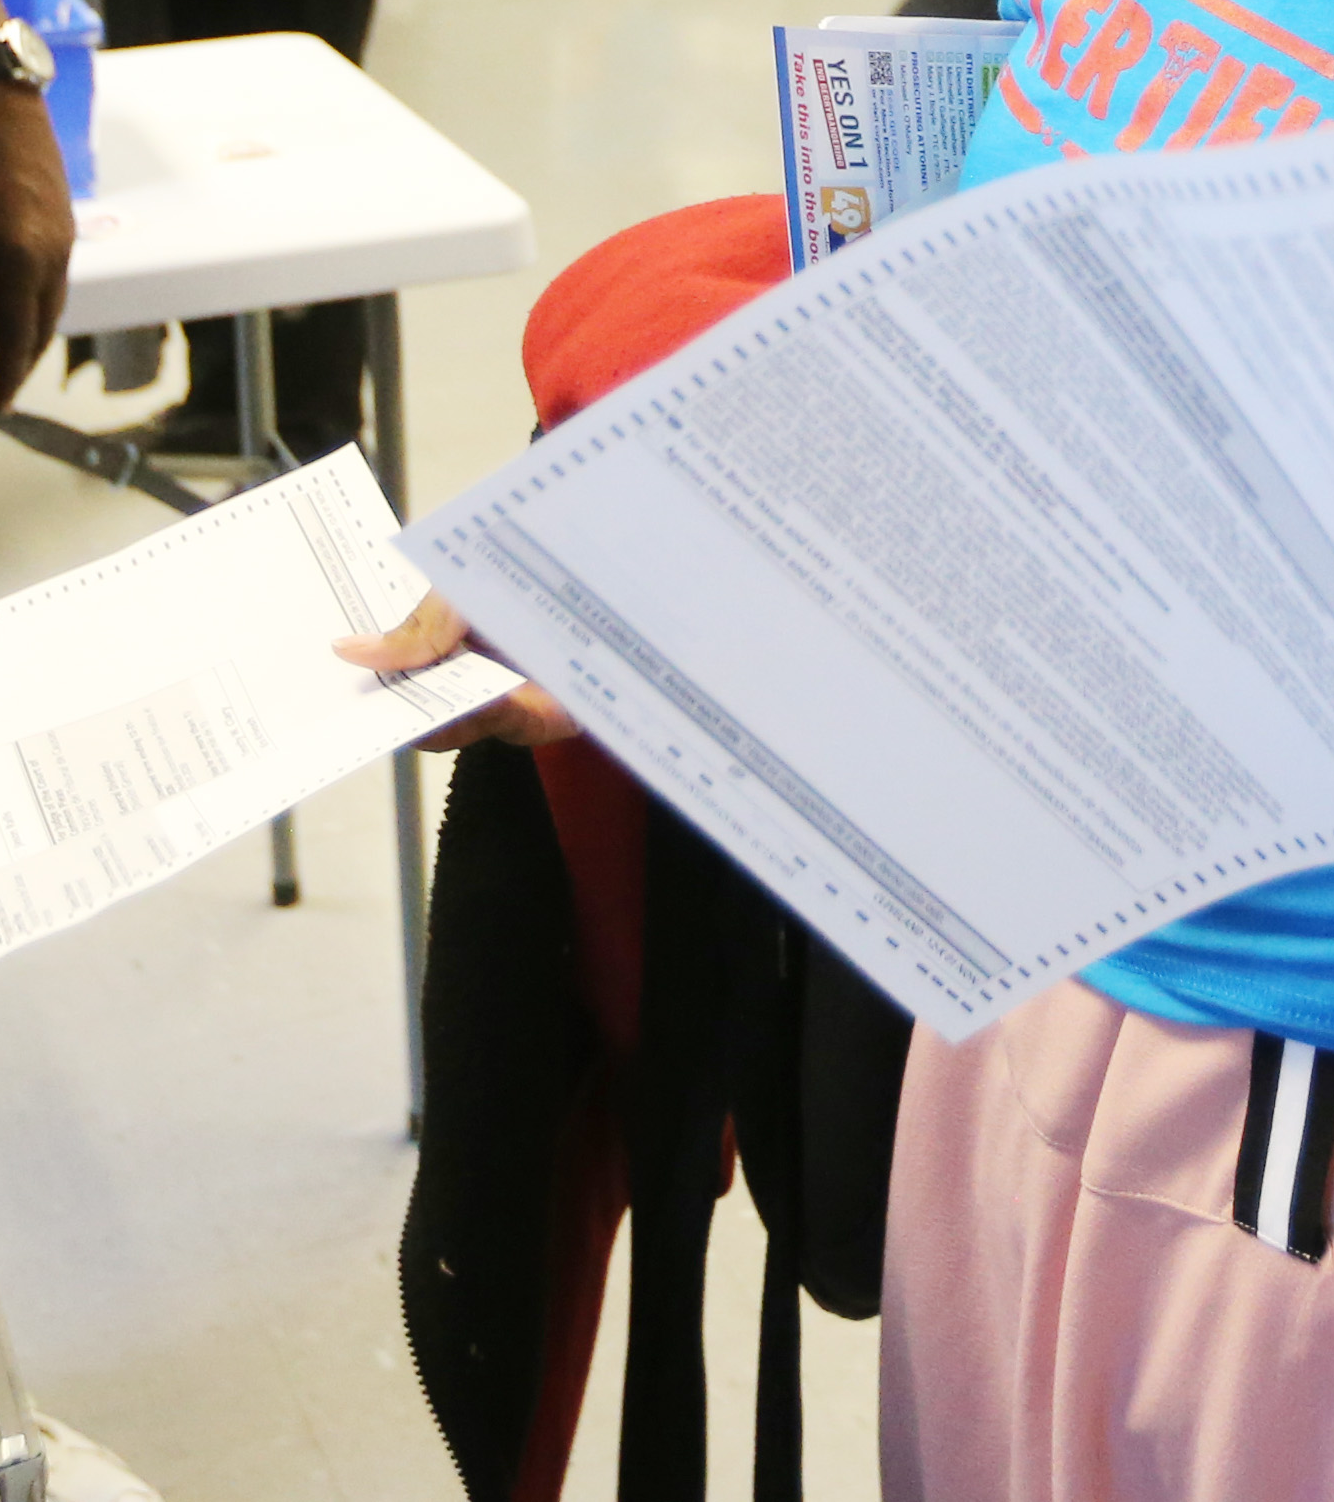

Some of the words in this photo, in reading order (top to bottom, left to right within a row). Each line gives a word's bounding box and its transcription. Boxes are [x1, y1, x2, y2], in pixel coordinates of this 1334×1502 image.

[792, 51, 807, 97] Take
[814, 60, 829, 82] END
[826, 58, 853, 108] YES
[910, 51, 924, 131] PROSECUTING
[796, 102, 811, 140] this
[818, 81, 845, 168] GERRYMANDERING
[838, 113, 864, 150] ON
[800, 145, 815, 185] into
[848, 156, 868, 169] 1
[804, 191, 817, 223] the
